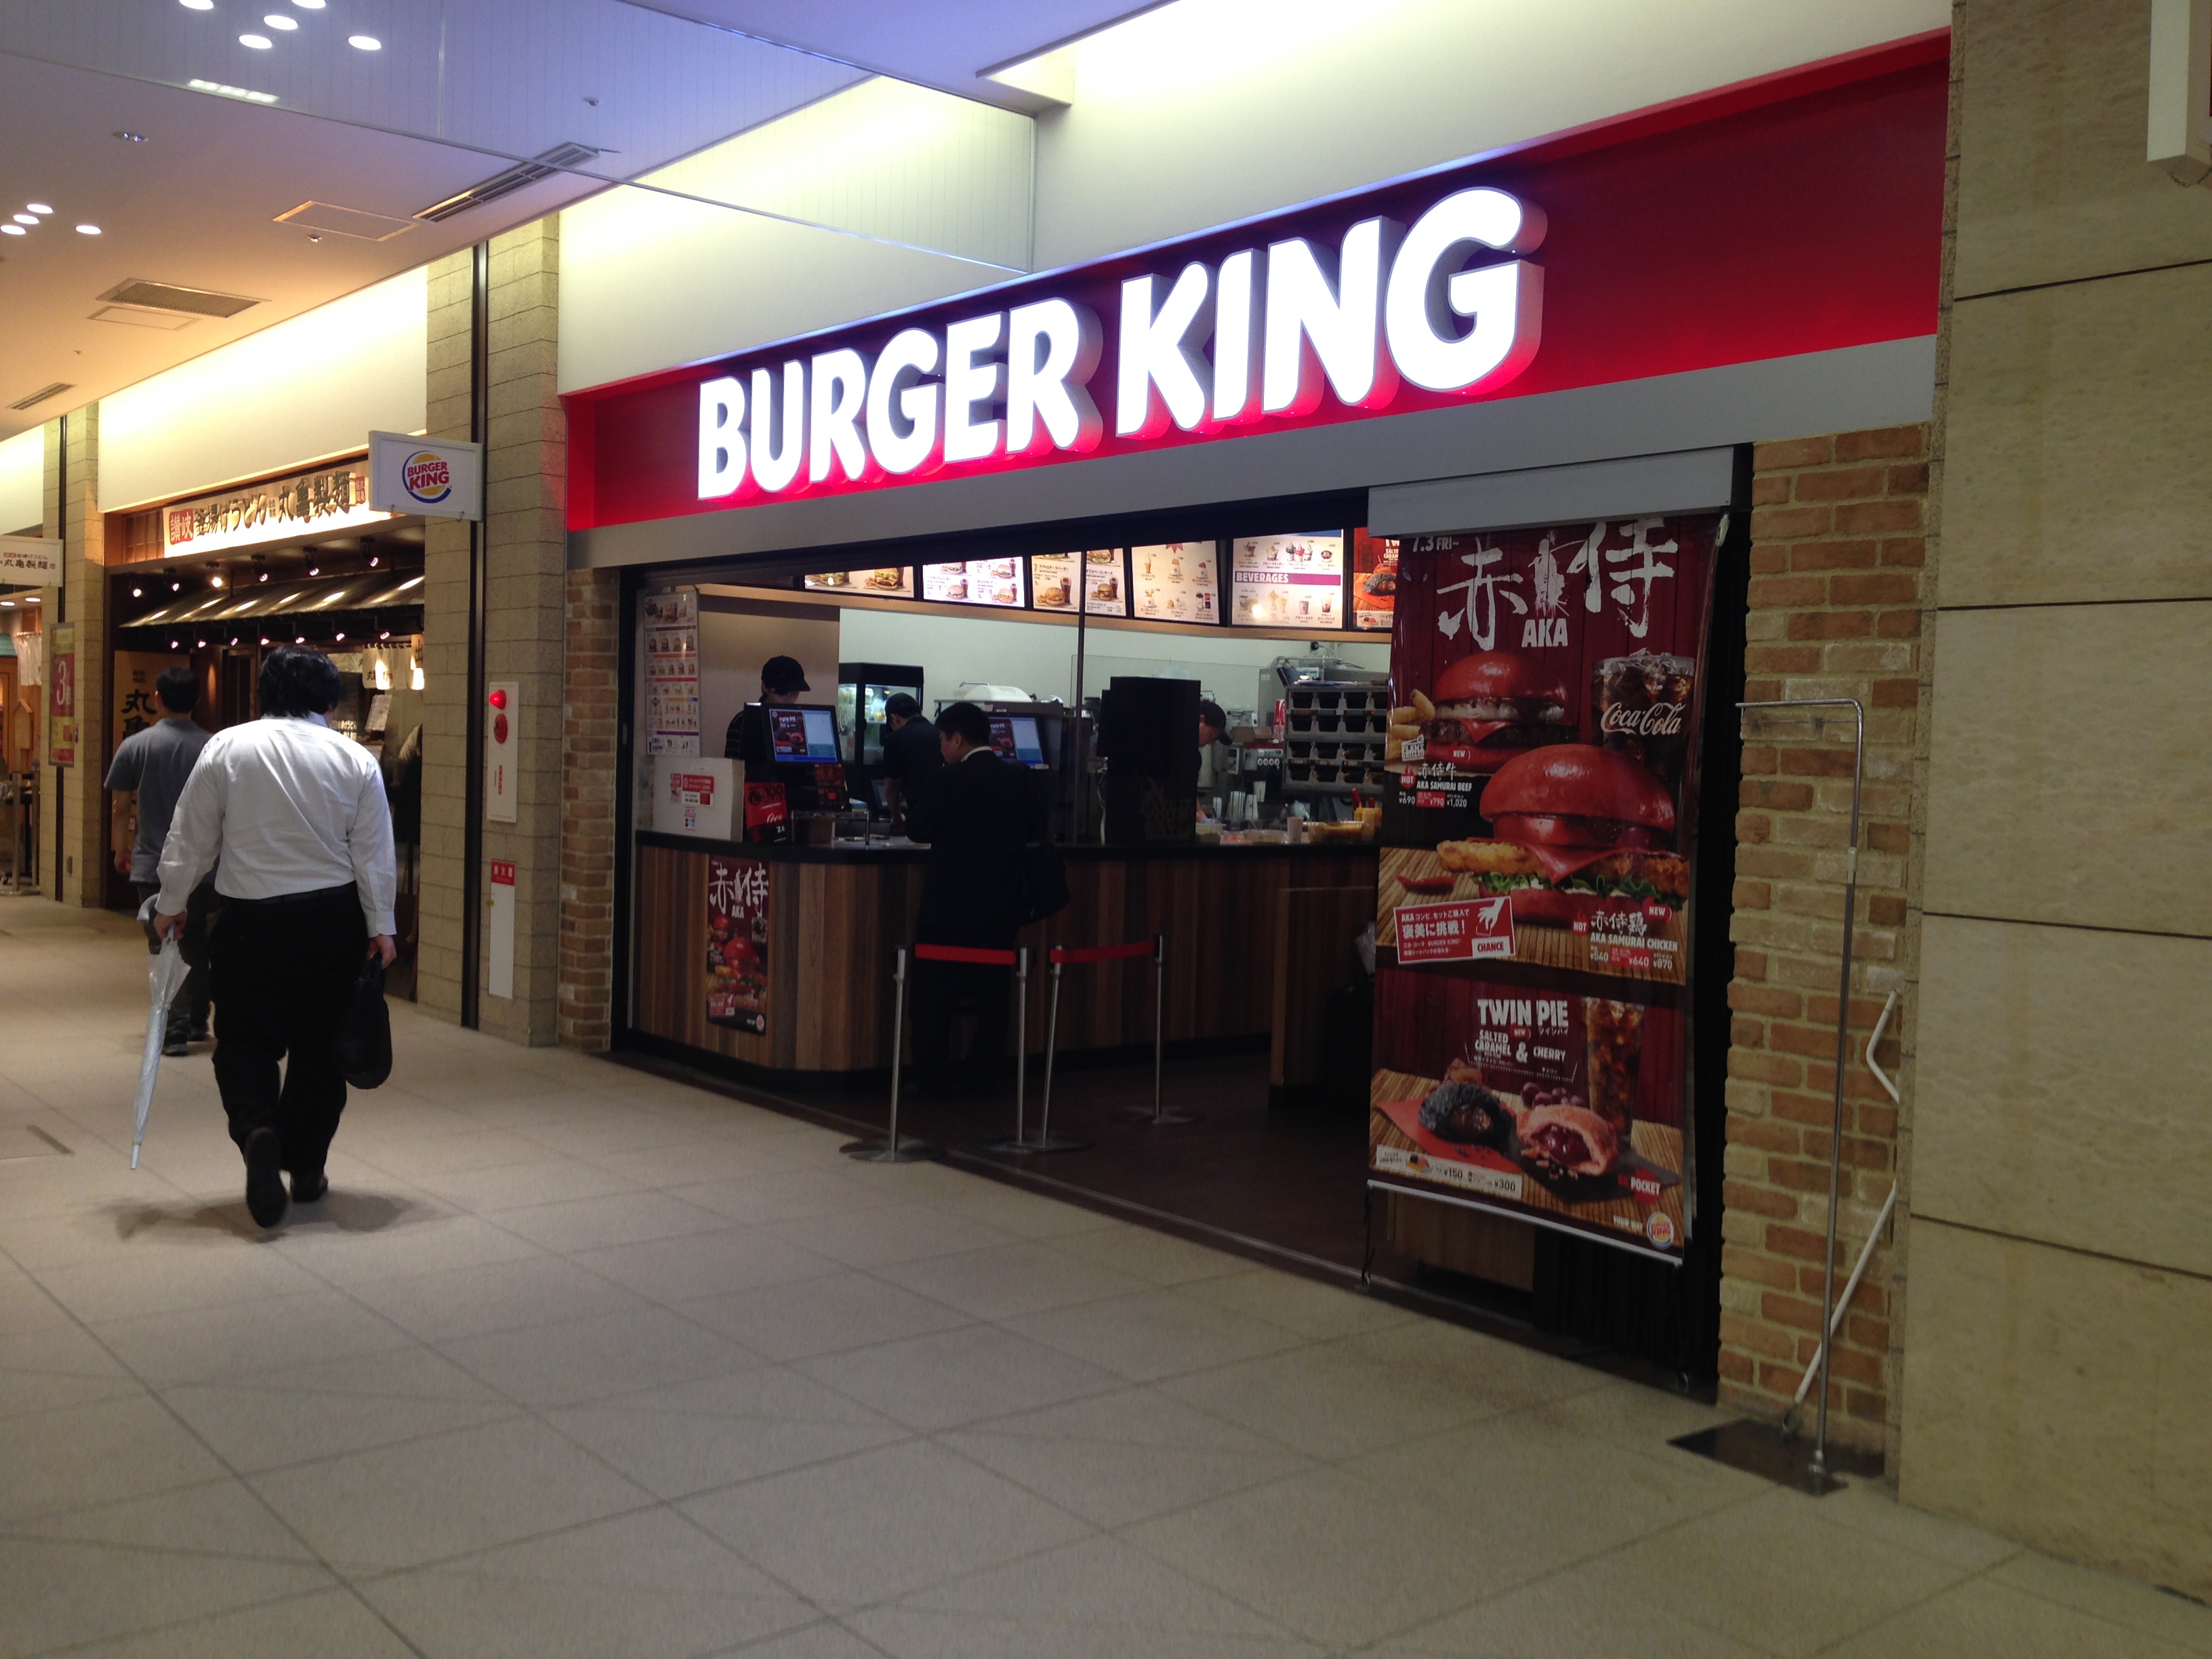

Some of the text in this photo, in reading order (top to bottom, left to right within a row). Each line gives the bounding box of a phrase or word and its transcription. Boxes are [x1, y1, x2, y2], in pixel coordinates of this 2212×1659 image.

[697, 185, 1533, 500] BURGER KING
[407, 462, 448, 477] BURGER
[409, 471, 450, 491] KING
[1235, 572, 1289, 583] BEVERAGES
[1521, 618, 1569, 648] AKA
[1600, 702, 1686, 735] Coca-Cola
[1453, 750, 1466, 758] NEW
[1401, 775, 1414, 784] HOT
[1416, 780, 1473, 792] AKA SAMURAI BEEF
[732, 904, 745, 919] AKA
[1649, 906, 1666, 916] NEW
[1574, 922, 1587, 933] HOT
[1477, 942, 1504, 952] CHANCE
[1590, 932, 1678, 952] AKA SAMURAI CHICKEN
[1477, 998, 1569, 1027] TWIN PIE
[1479, 1029, 1509, 1044] SALTED
[1475, 1038, 1512, 1057] CARAMEL
[1533, 1045, 1566, 1063] CHERRY
